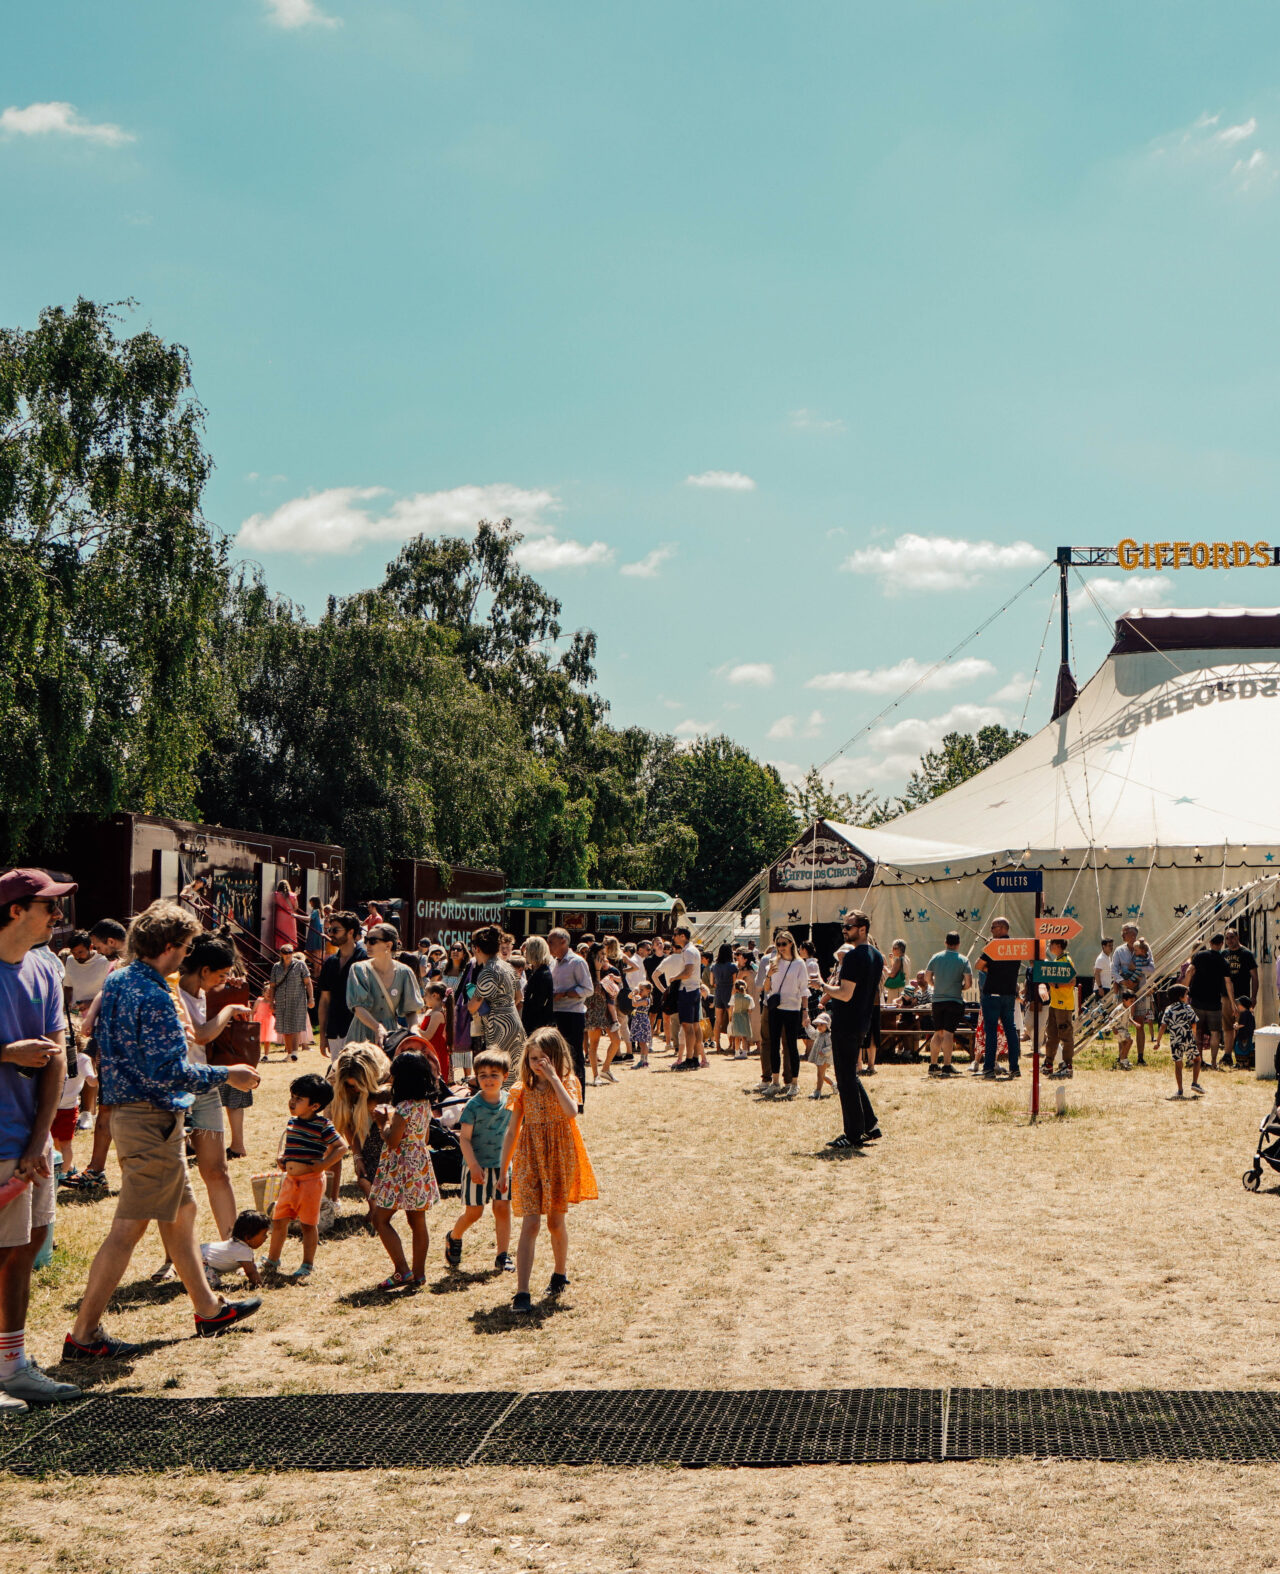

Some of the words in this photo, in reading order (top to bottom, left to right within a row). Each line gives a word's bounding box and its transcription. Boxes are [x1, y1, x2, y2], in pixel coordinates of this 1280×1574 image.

[1117, 538, 1271, 571] GIFFORDS
[785, 868, 825, 882] GIFFODS
[827, 867, 857, 878] CIRCUS
[996, 876, 1028, 887] TOILETS
[417, 900, 466, 920] GIFFORDS
[468, 905, 501, 923] CIRCUS
[1040, 923, 1069, 935] Shop
[997, 943, 1028, 956] CAFÉ
[1041, 966, 1071, 977] TREATS
